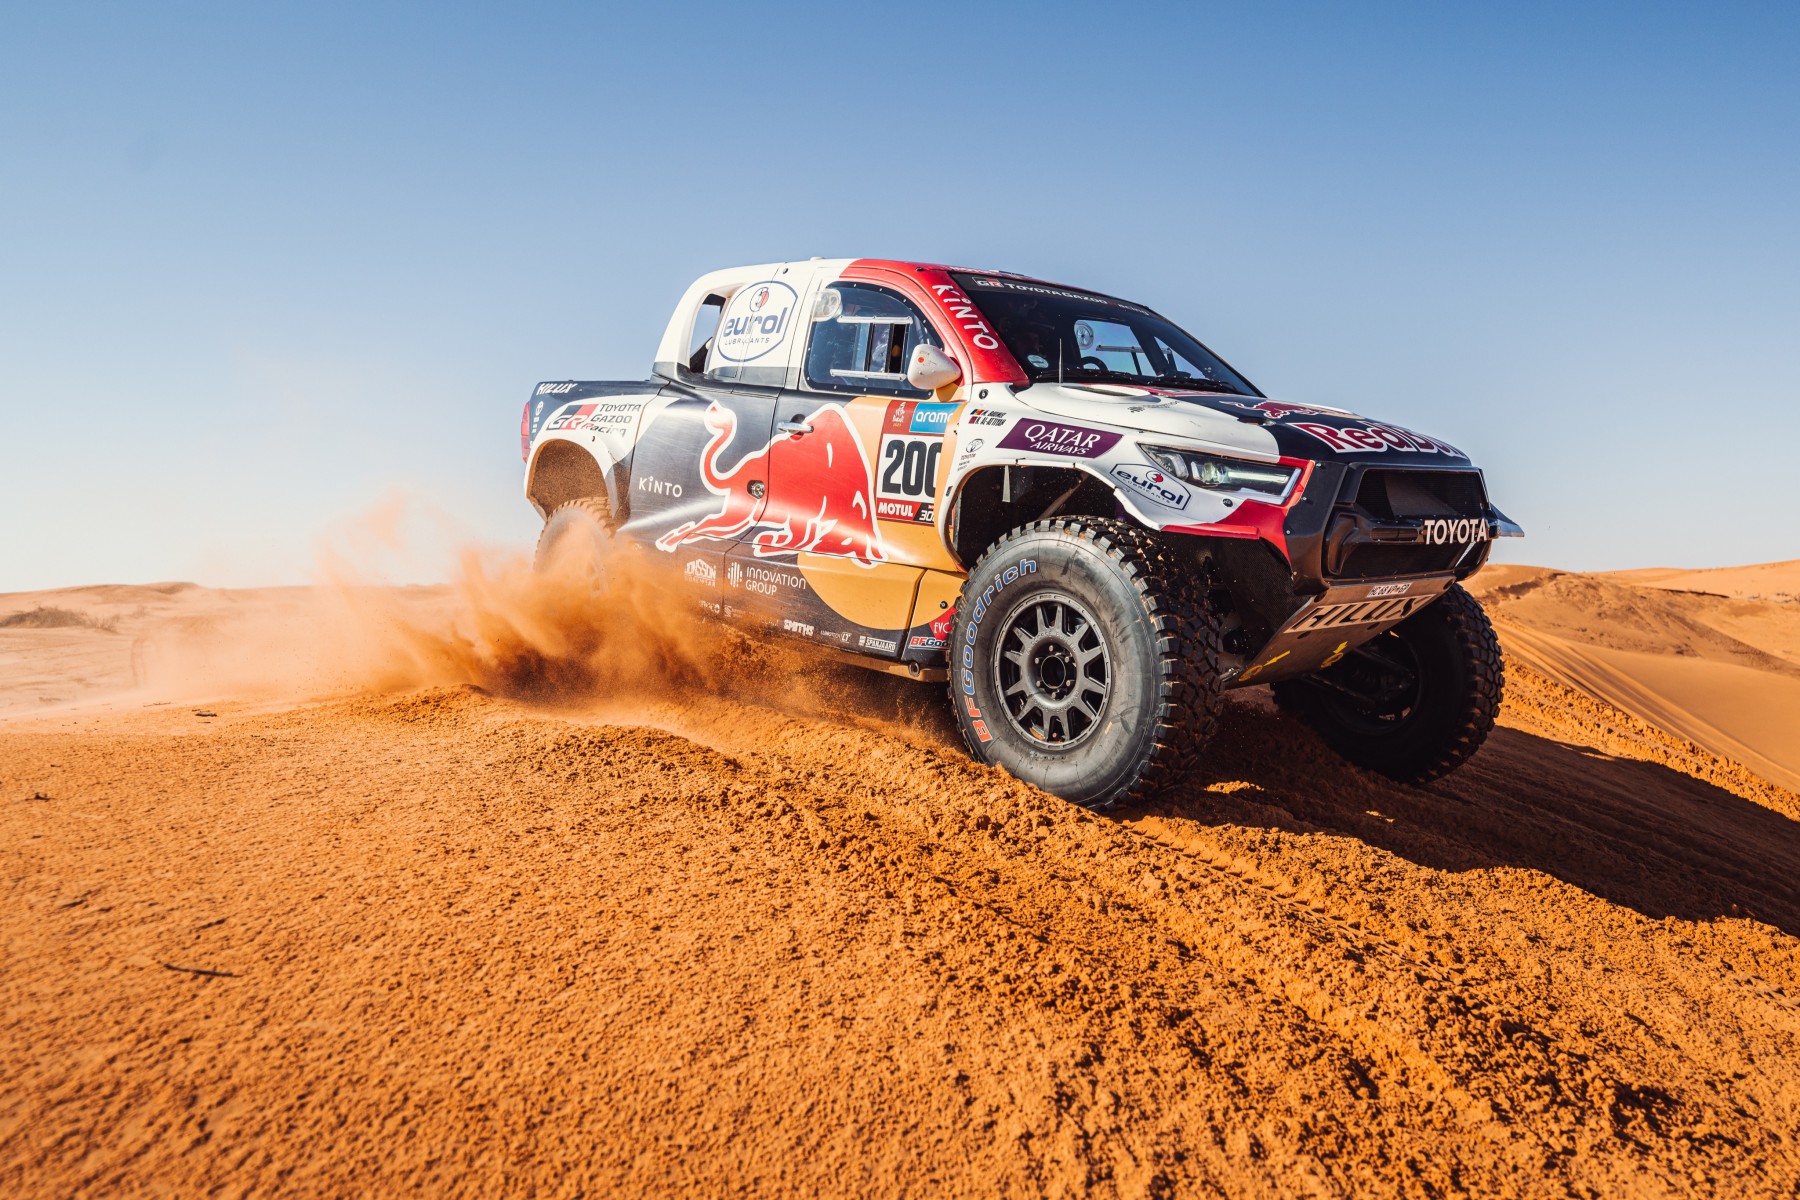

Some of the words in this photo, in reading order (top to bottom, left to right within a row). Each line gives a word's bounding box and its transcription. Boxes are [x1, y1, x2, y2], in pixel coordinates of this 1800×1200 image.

[1004, 283, 1060, 296] TOYOTA
[723, 307, 788, 337] eurol
[536, 383, 578, 396] HILUX
[599, 403, 642, 413] TOYOTA
[547, 414, 589, 430] GR
[590, 414, 632, 424] GAZOO
[915, 411, 953, 423] aram
[1024, 424, 1101, 449] QATAR
[1030, 441, 1091, 455] AIRWAYS
[1116, 470, 1184, 505] eurol
[878, 501, 914, 518] MOTUL
[1424, 519, 1489, 545] TOYOTA
[746, 566, 806, 590] INNOVATION
[745, 580, 777, 596] GROUP
[1290, 595, 1436, 631] HILUX
[783, 619, 815, 637] SMITHS
[865, 638, 897, 652] SPANJAARD
[910, 636, 949, 647] BFGoo
